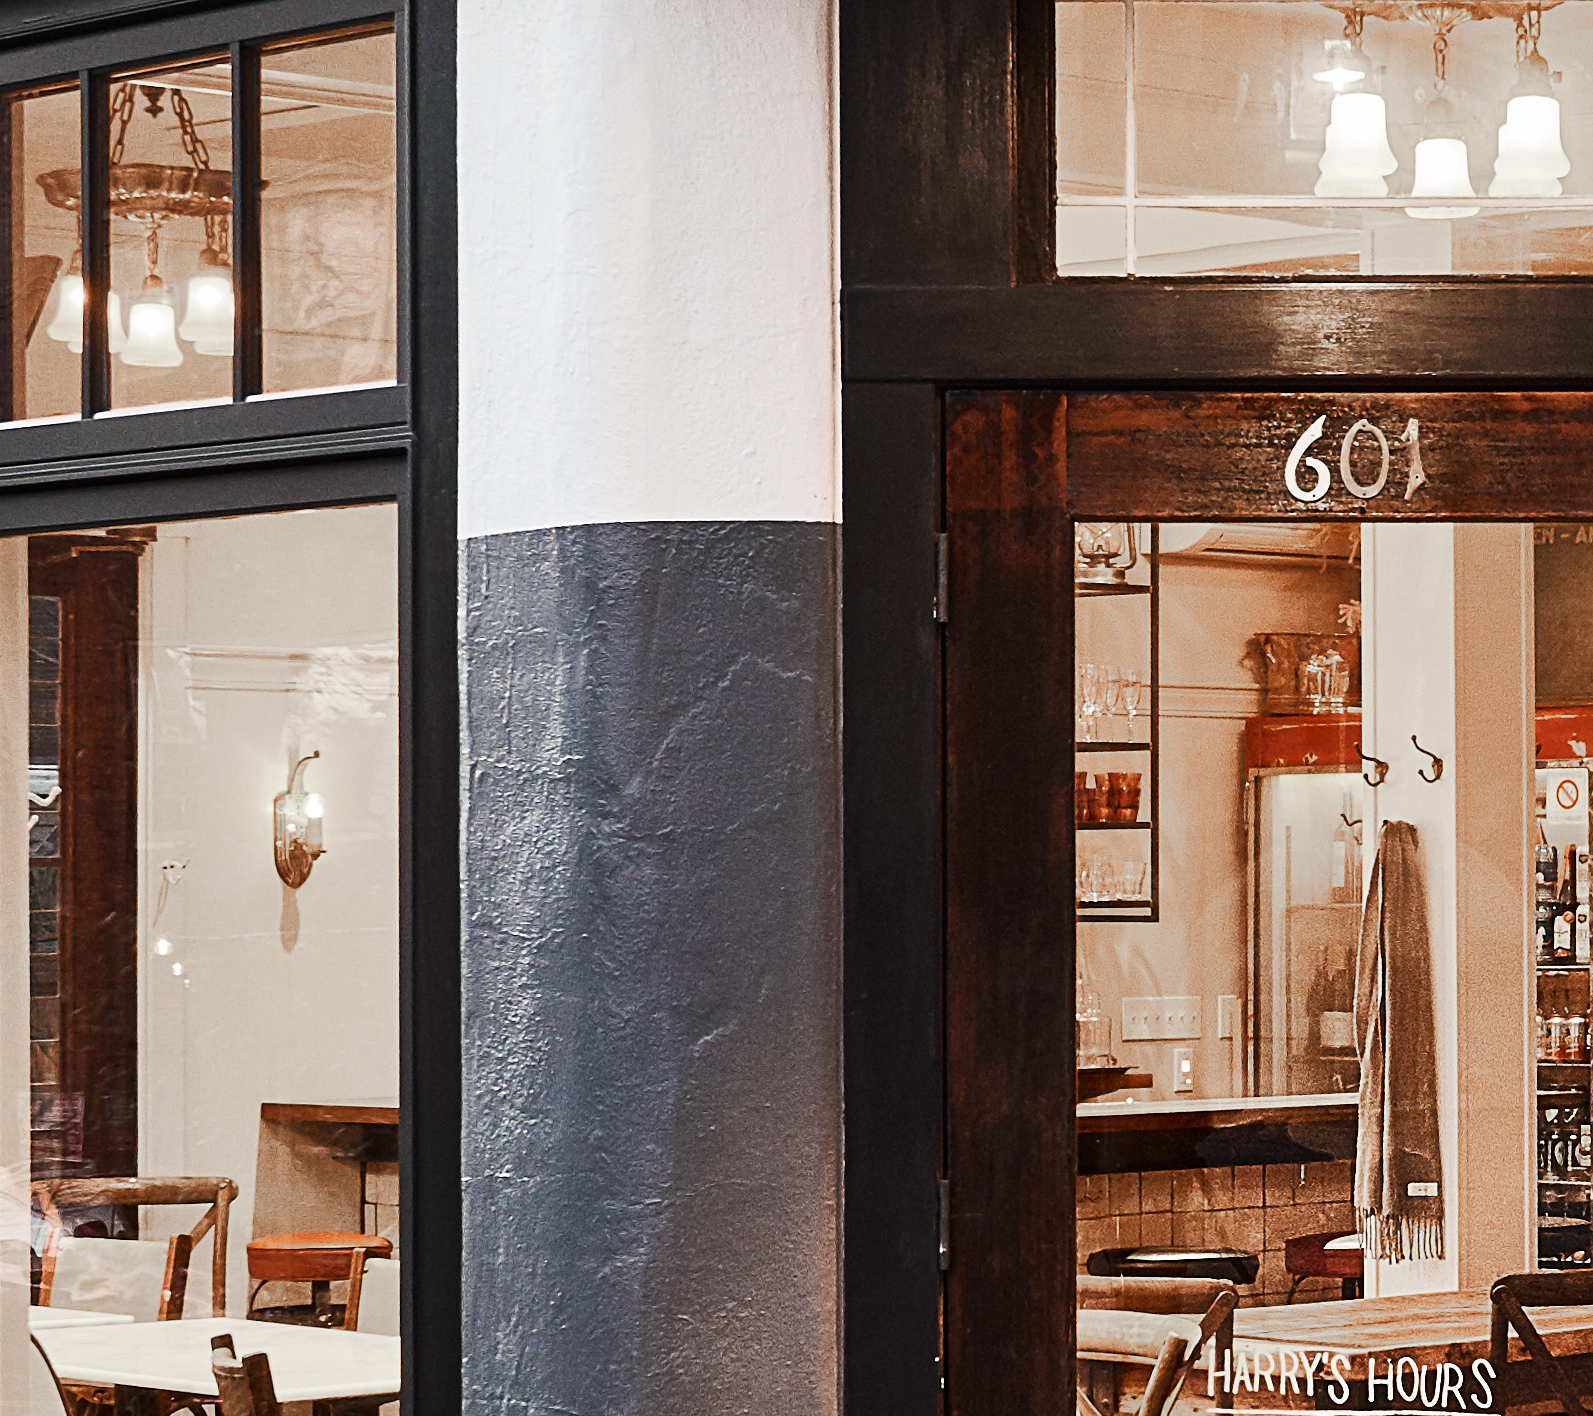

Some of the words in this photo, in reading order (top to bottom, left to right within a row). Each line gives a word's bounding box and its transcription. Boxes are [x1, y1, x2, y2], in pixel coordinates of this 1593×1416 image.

[1284, 414, 1430, 502] 601
[1206, 1348, 1352, 1405] HARRY'S
[1367, 1355, 1497, 1410] HOURS
